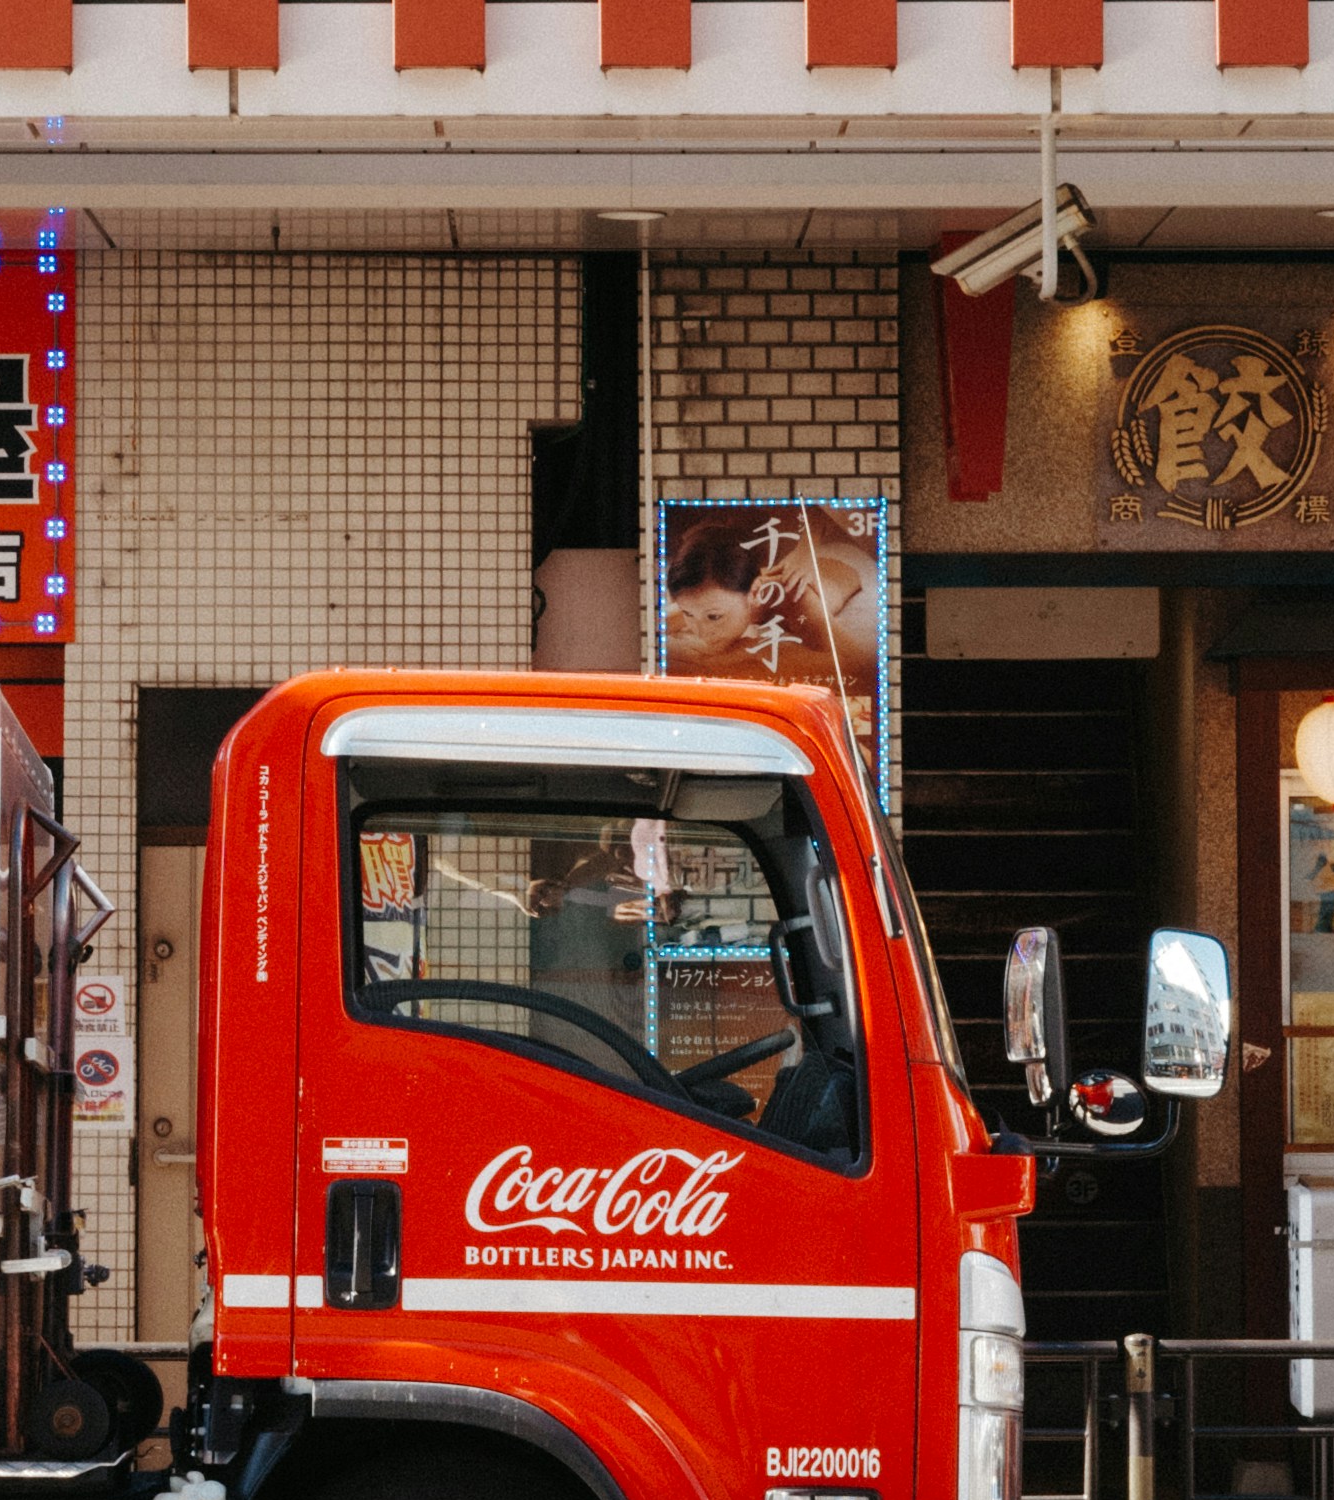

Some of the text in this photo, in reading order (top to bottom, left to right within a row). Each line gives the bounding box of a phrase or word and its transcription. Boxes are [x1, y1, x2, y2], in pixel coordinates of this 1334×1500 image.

[1138, 353, 1298, 494] 餃
[739, 517, 803, 674] 千の手
[465, 1145, 746, 1237] Coca-Cola
[465, 1246, 734, 1271] BOTTLERS JAPAN INC.
[766, 1446, 881, 1479] BJI2200016
